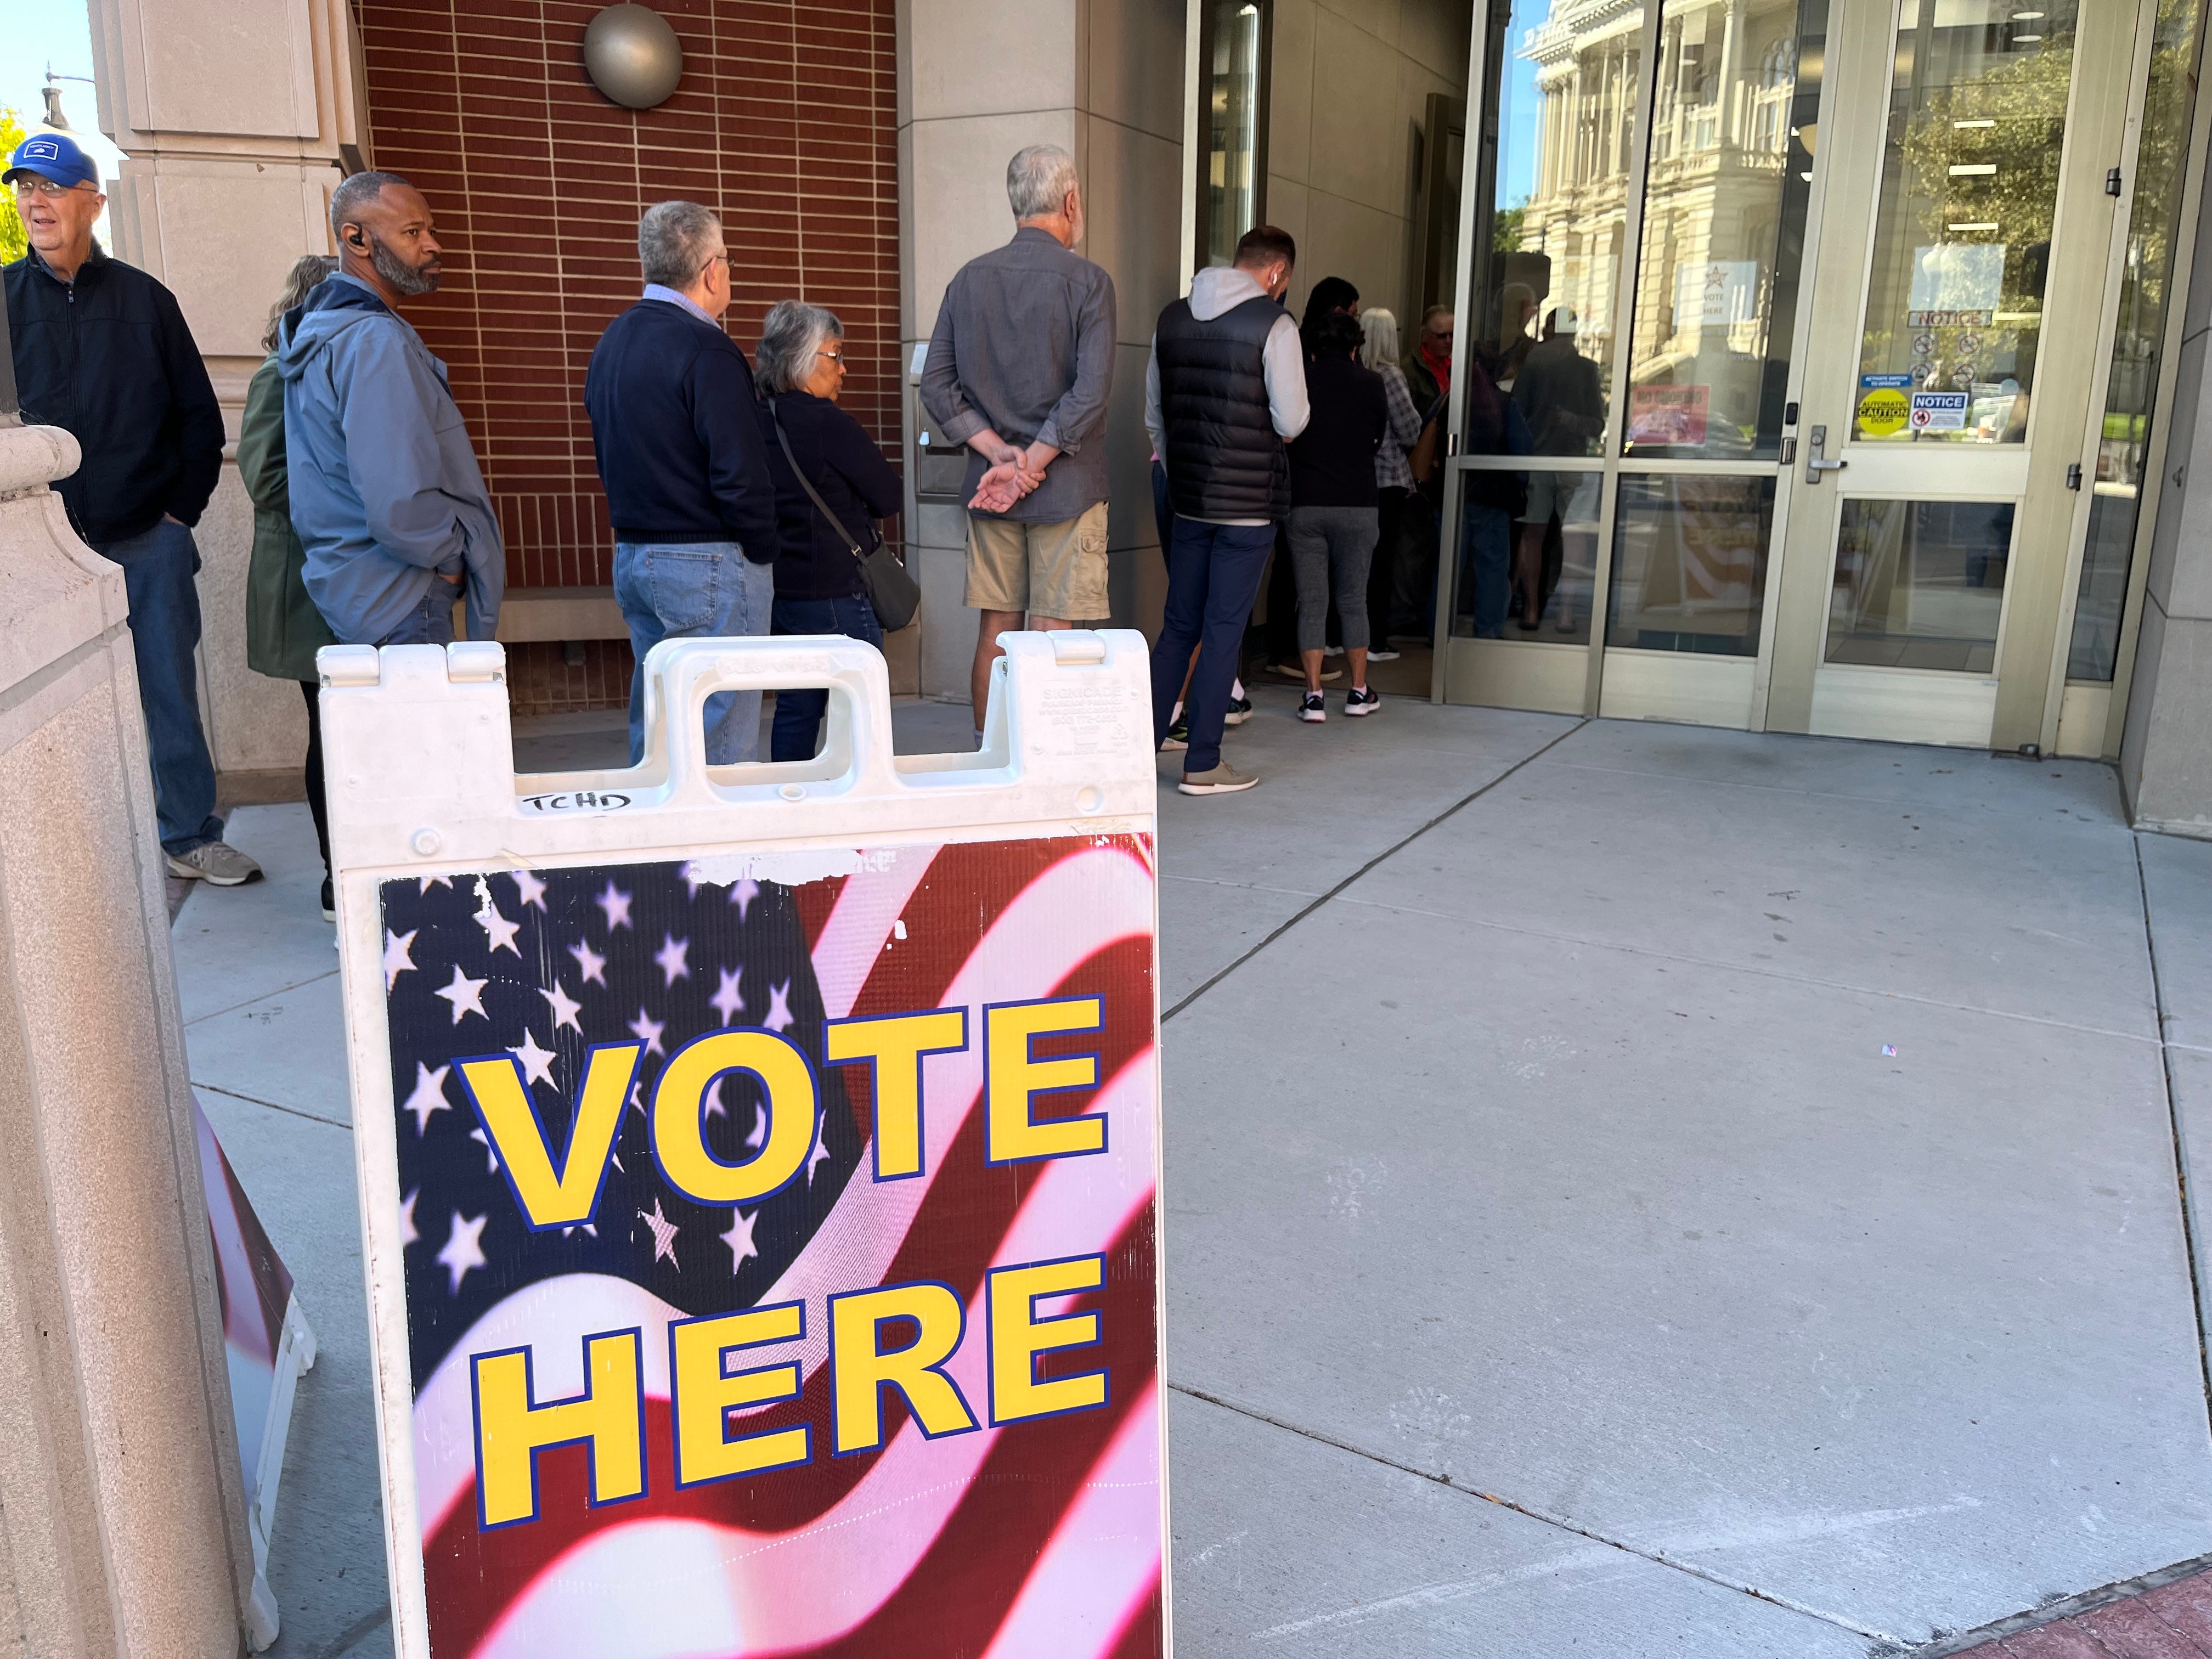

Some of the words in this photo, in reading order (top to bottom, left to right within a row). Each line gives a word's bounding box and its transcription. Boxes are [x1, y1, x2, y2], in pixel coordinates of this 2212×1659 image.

[1703, 293, 1724, 301] VOTE
[1703, 307, 1723, 315] HERE
[1918, 311, 1982, 325] NOTICE
[1916, 397, 1962, 407] NOTICE
[1859, 408, 1909, 417] CAUTION
[1044, 687, 1122, 699] SIGNICADE
[522, 792, 631, 811] TCHD
[451, 993, 1109, 1233] VOTE
[470, 1251, 1110, 1534] HERE
